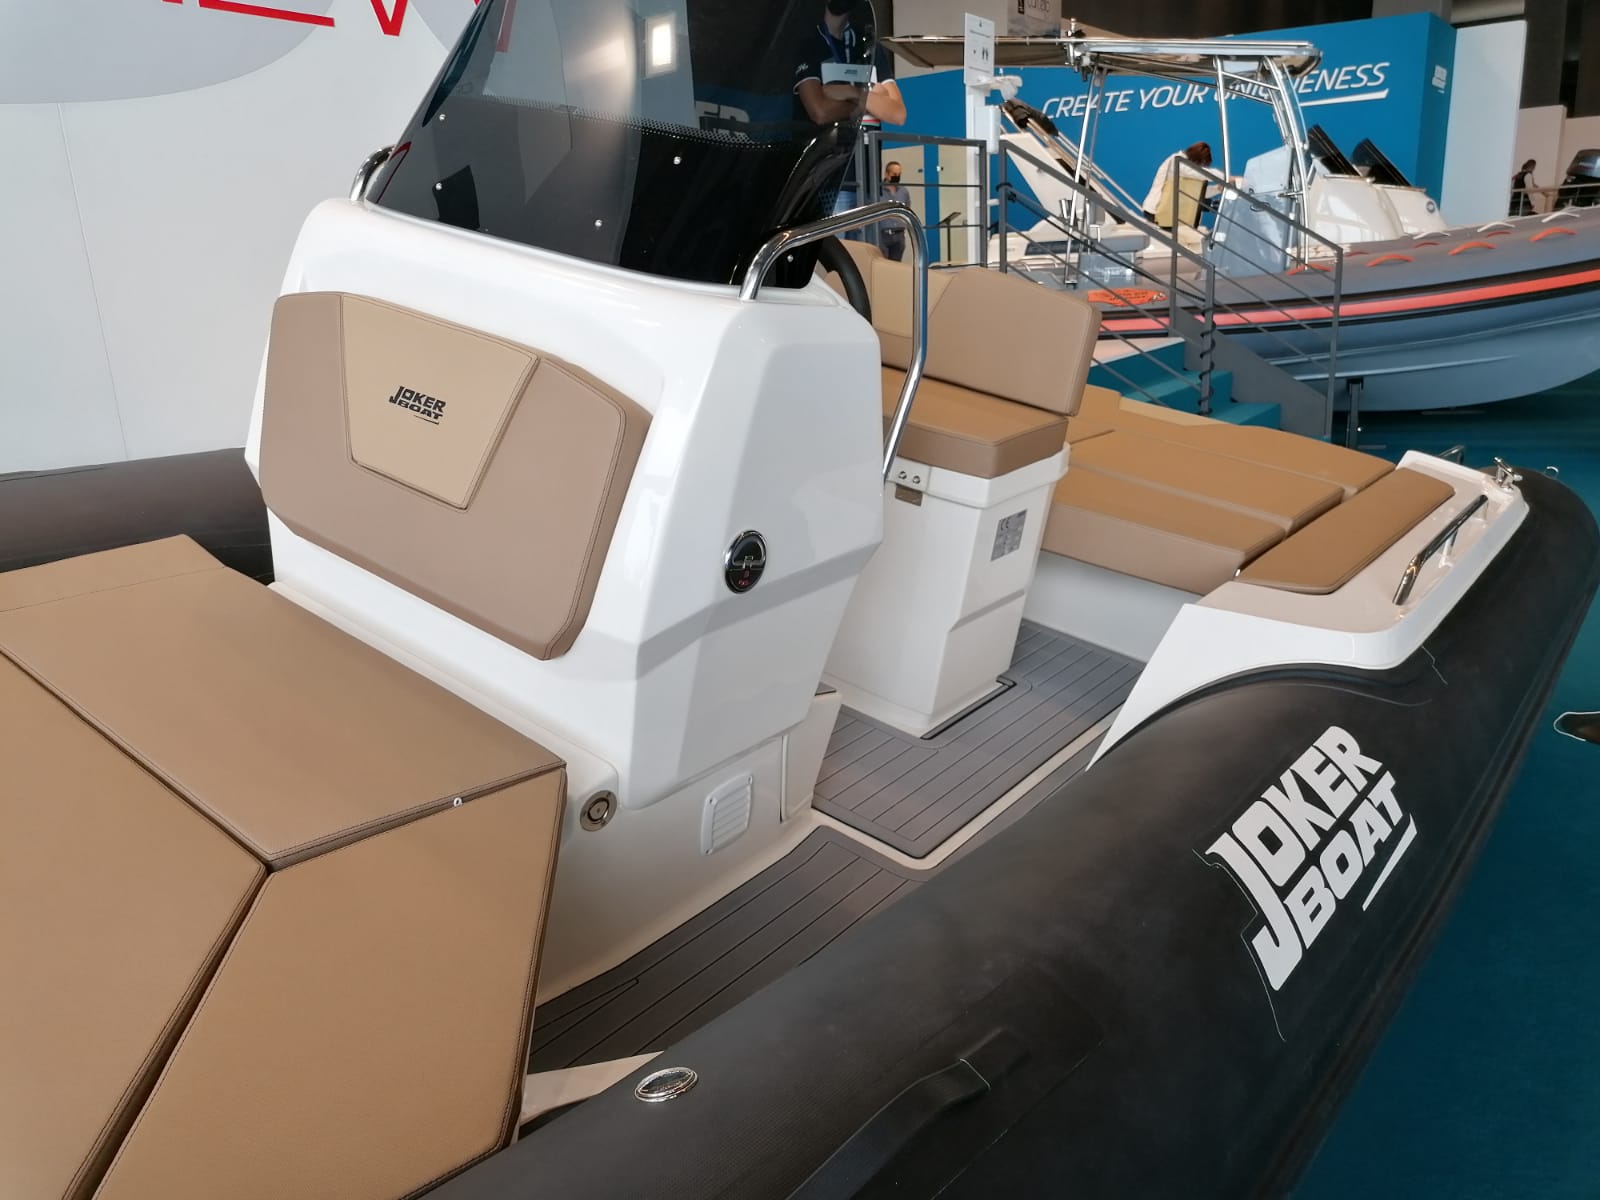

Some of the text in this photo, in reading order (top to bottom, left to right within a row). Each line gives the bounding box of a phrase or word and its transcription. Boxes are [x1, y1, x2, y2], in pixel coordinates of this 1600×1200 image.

[1042, 62, 1390, 119] CREATE YOUR NIENESS
[388, 385, 447, 413] JOKER
[397, 399, 443, 420] BOAT
[1205, 725, 1383, 991] JOKER
[1283, 770, 1404, 949] BOAT
